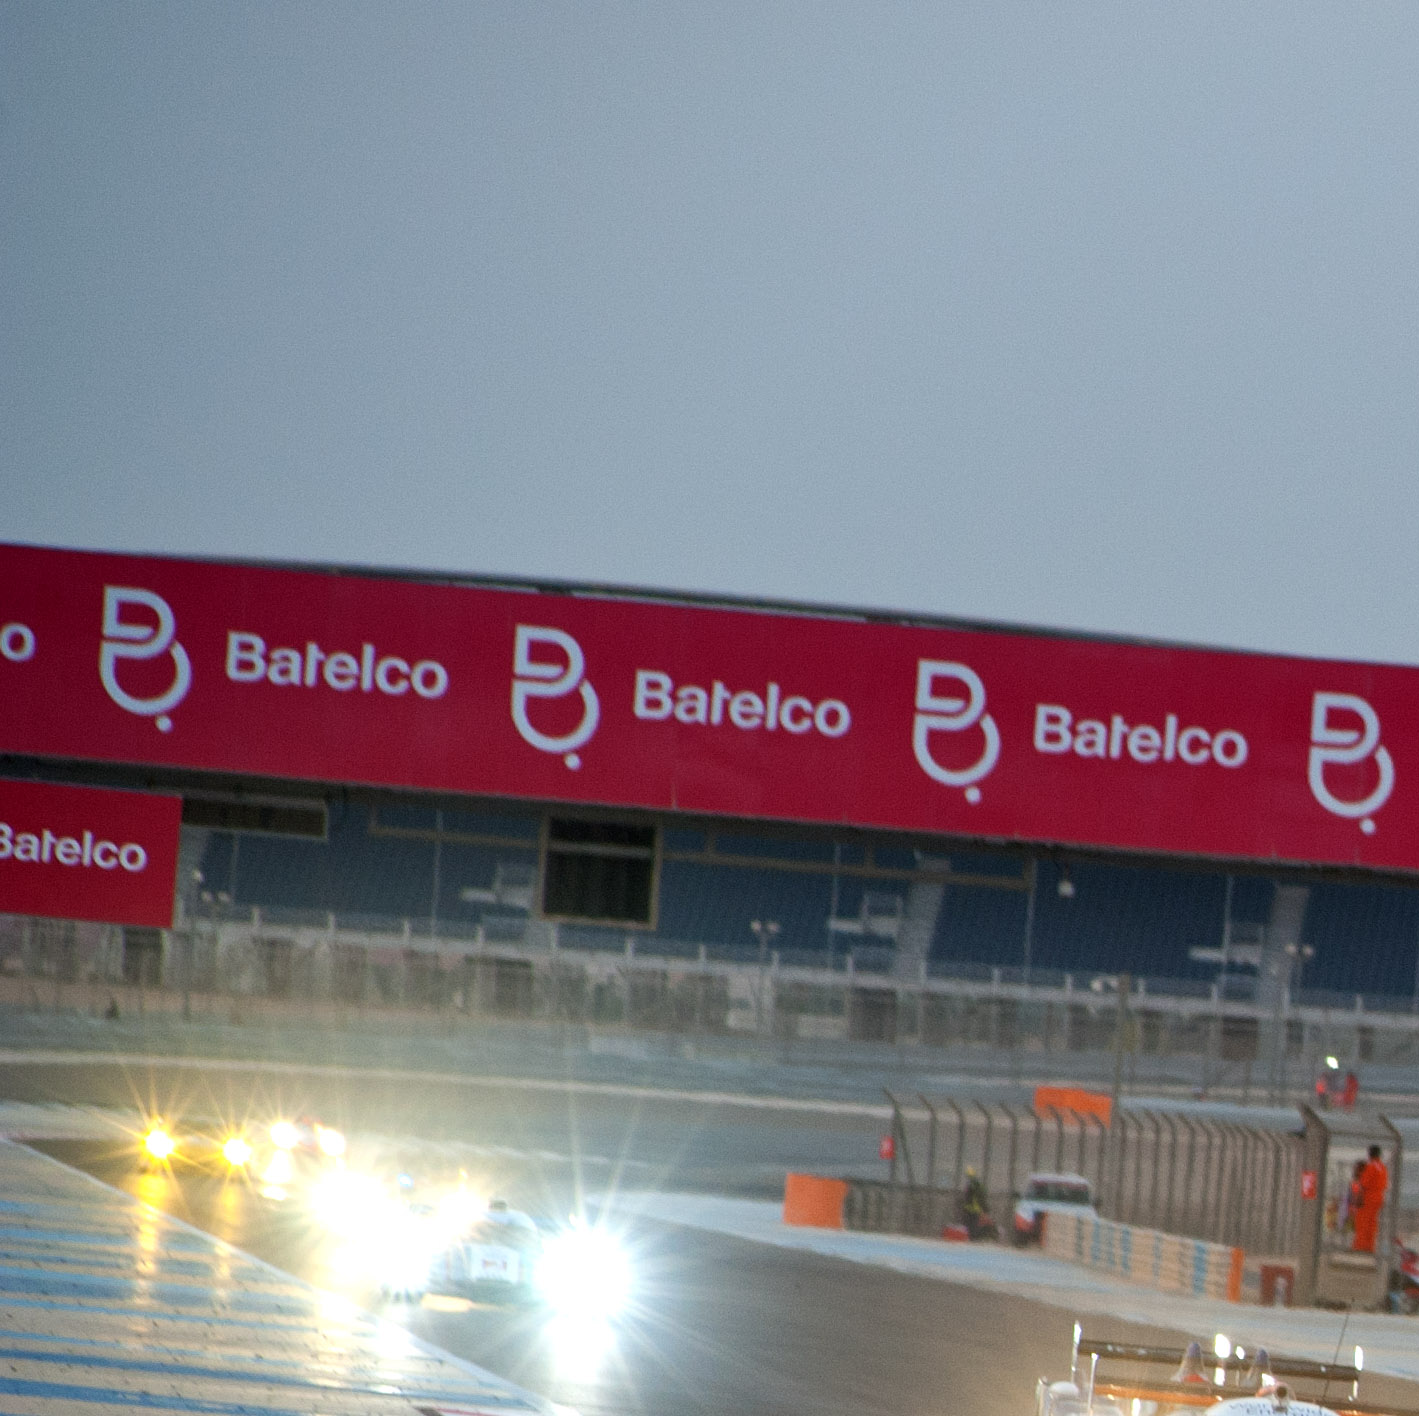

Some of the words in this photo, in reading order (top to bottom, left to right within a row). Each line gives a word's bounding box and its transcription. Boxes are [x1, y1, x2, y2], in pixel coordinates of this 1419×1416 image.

[225, 631, 449, 699] Batelco
[633, 669, 852, 737] Batelco
[1033, 703, 1249, 767] Batelco
